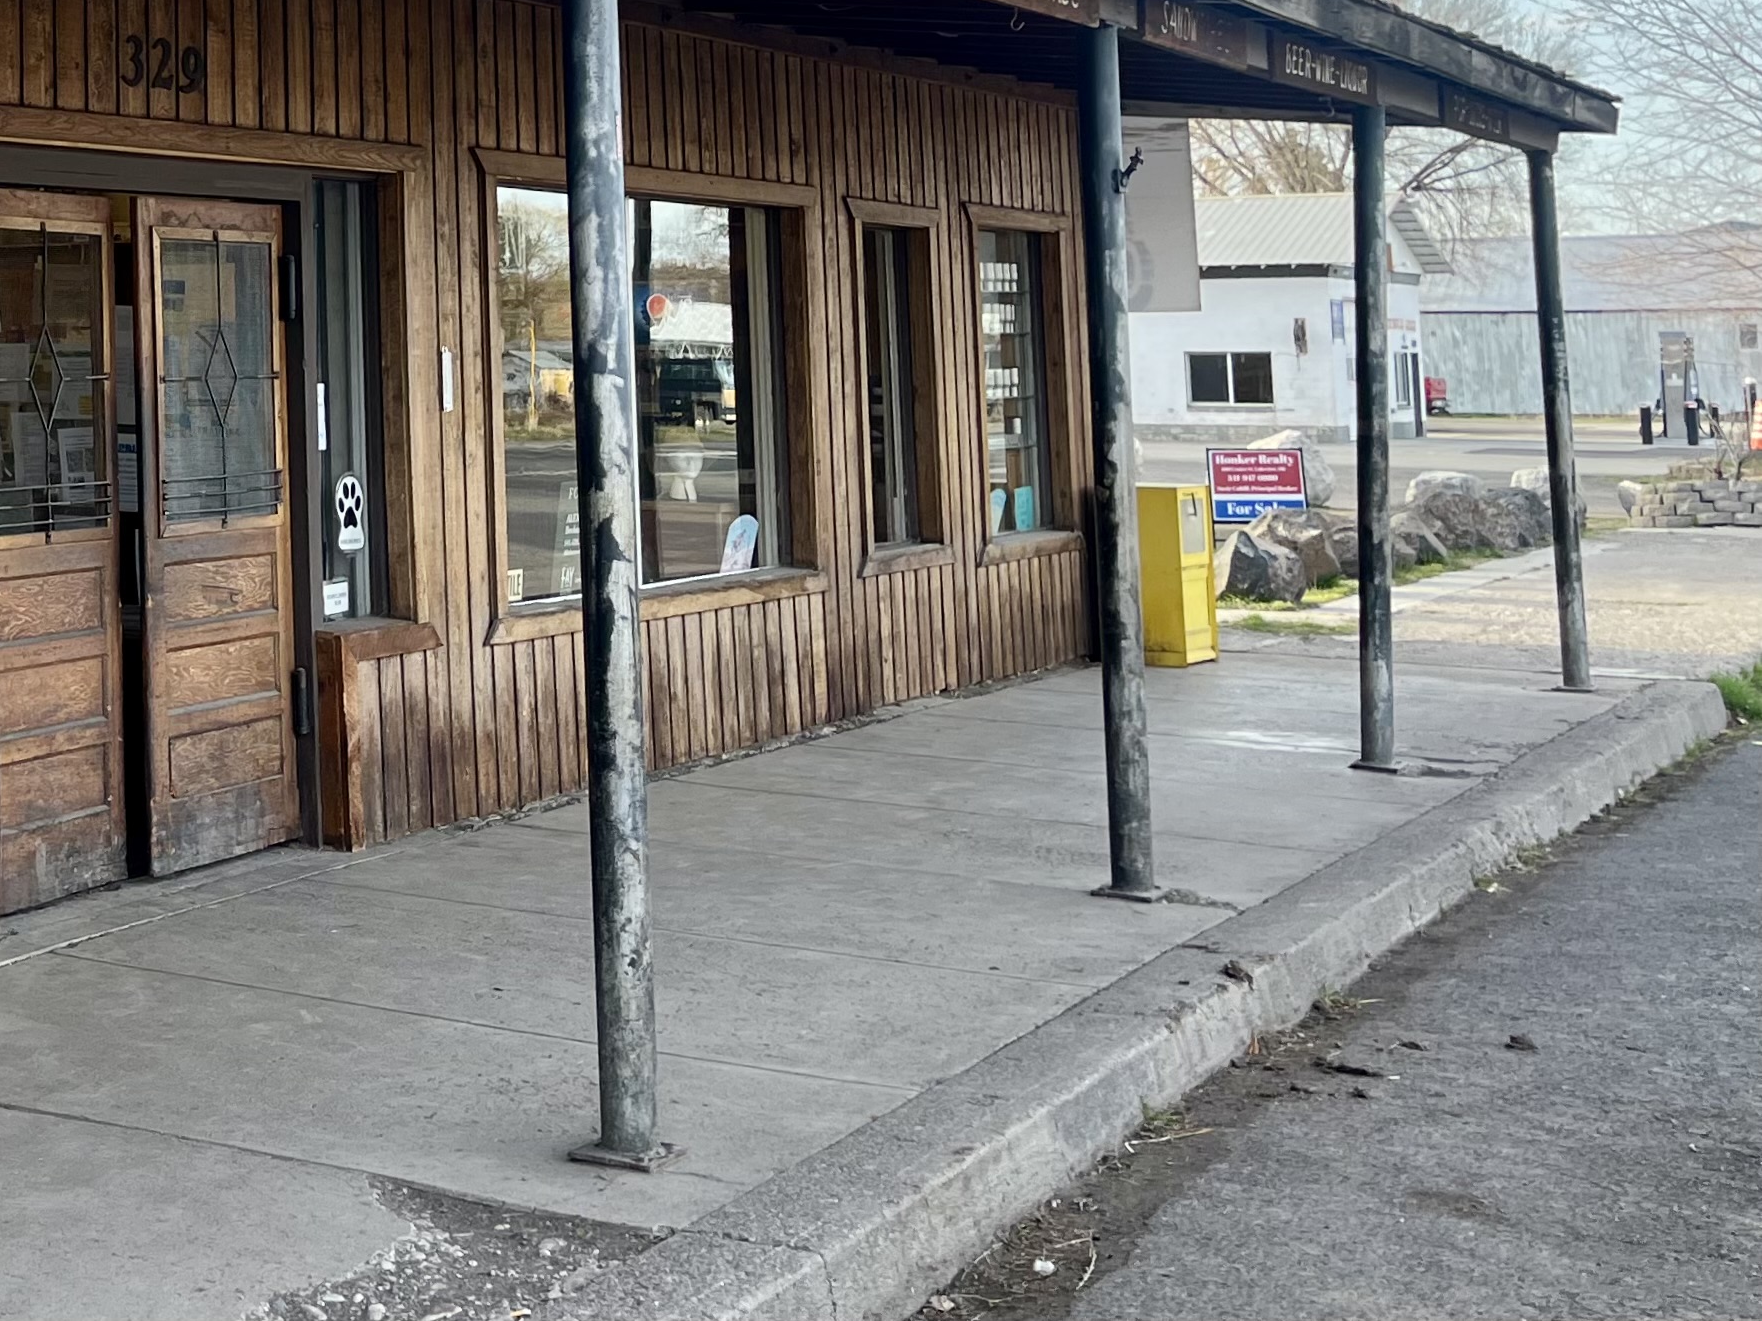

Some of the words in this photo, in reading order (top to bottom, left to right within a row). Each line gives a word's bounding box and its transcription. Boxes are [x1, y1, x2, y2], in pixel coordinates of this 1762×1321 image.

[121, 34, 204, 94] 329
[1258, 453, 1294, 467] Realty
[1227, 502, 1252, 515] For
[1254, 502, 1286, 516] Sal
